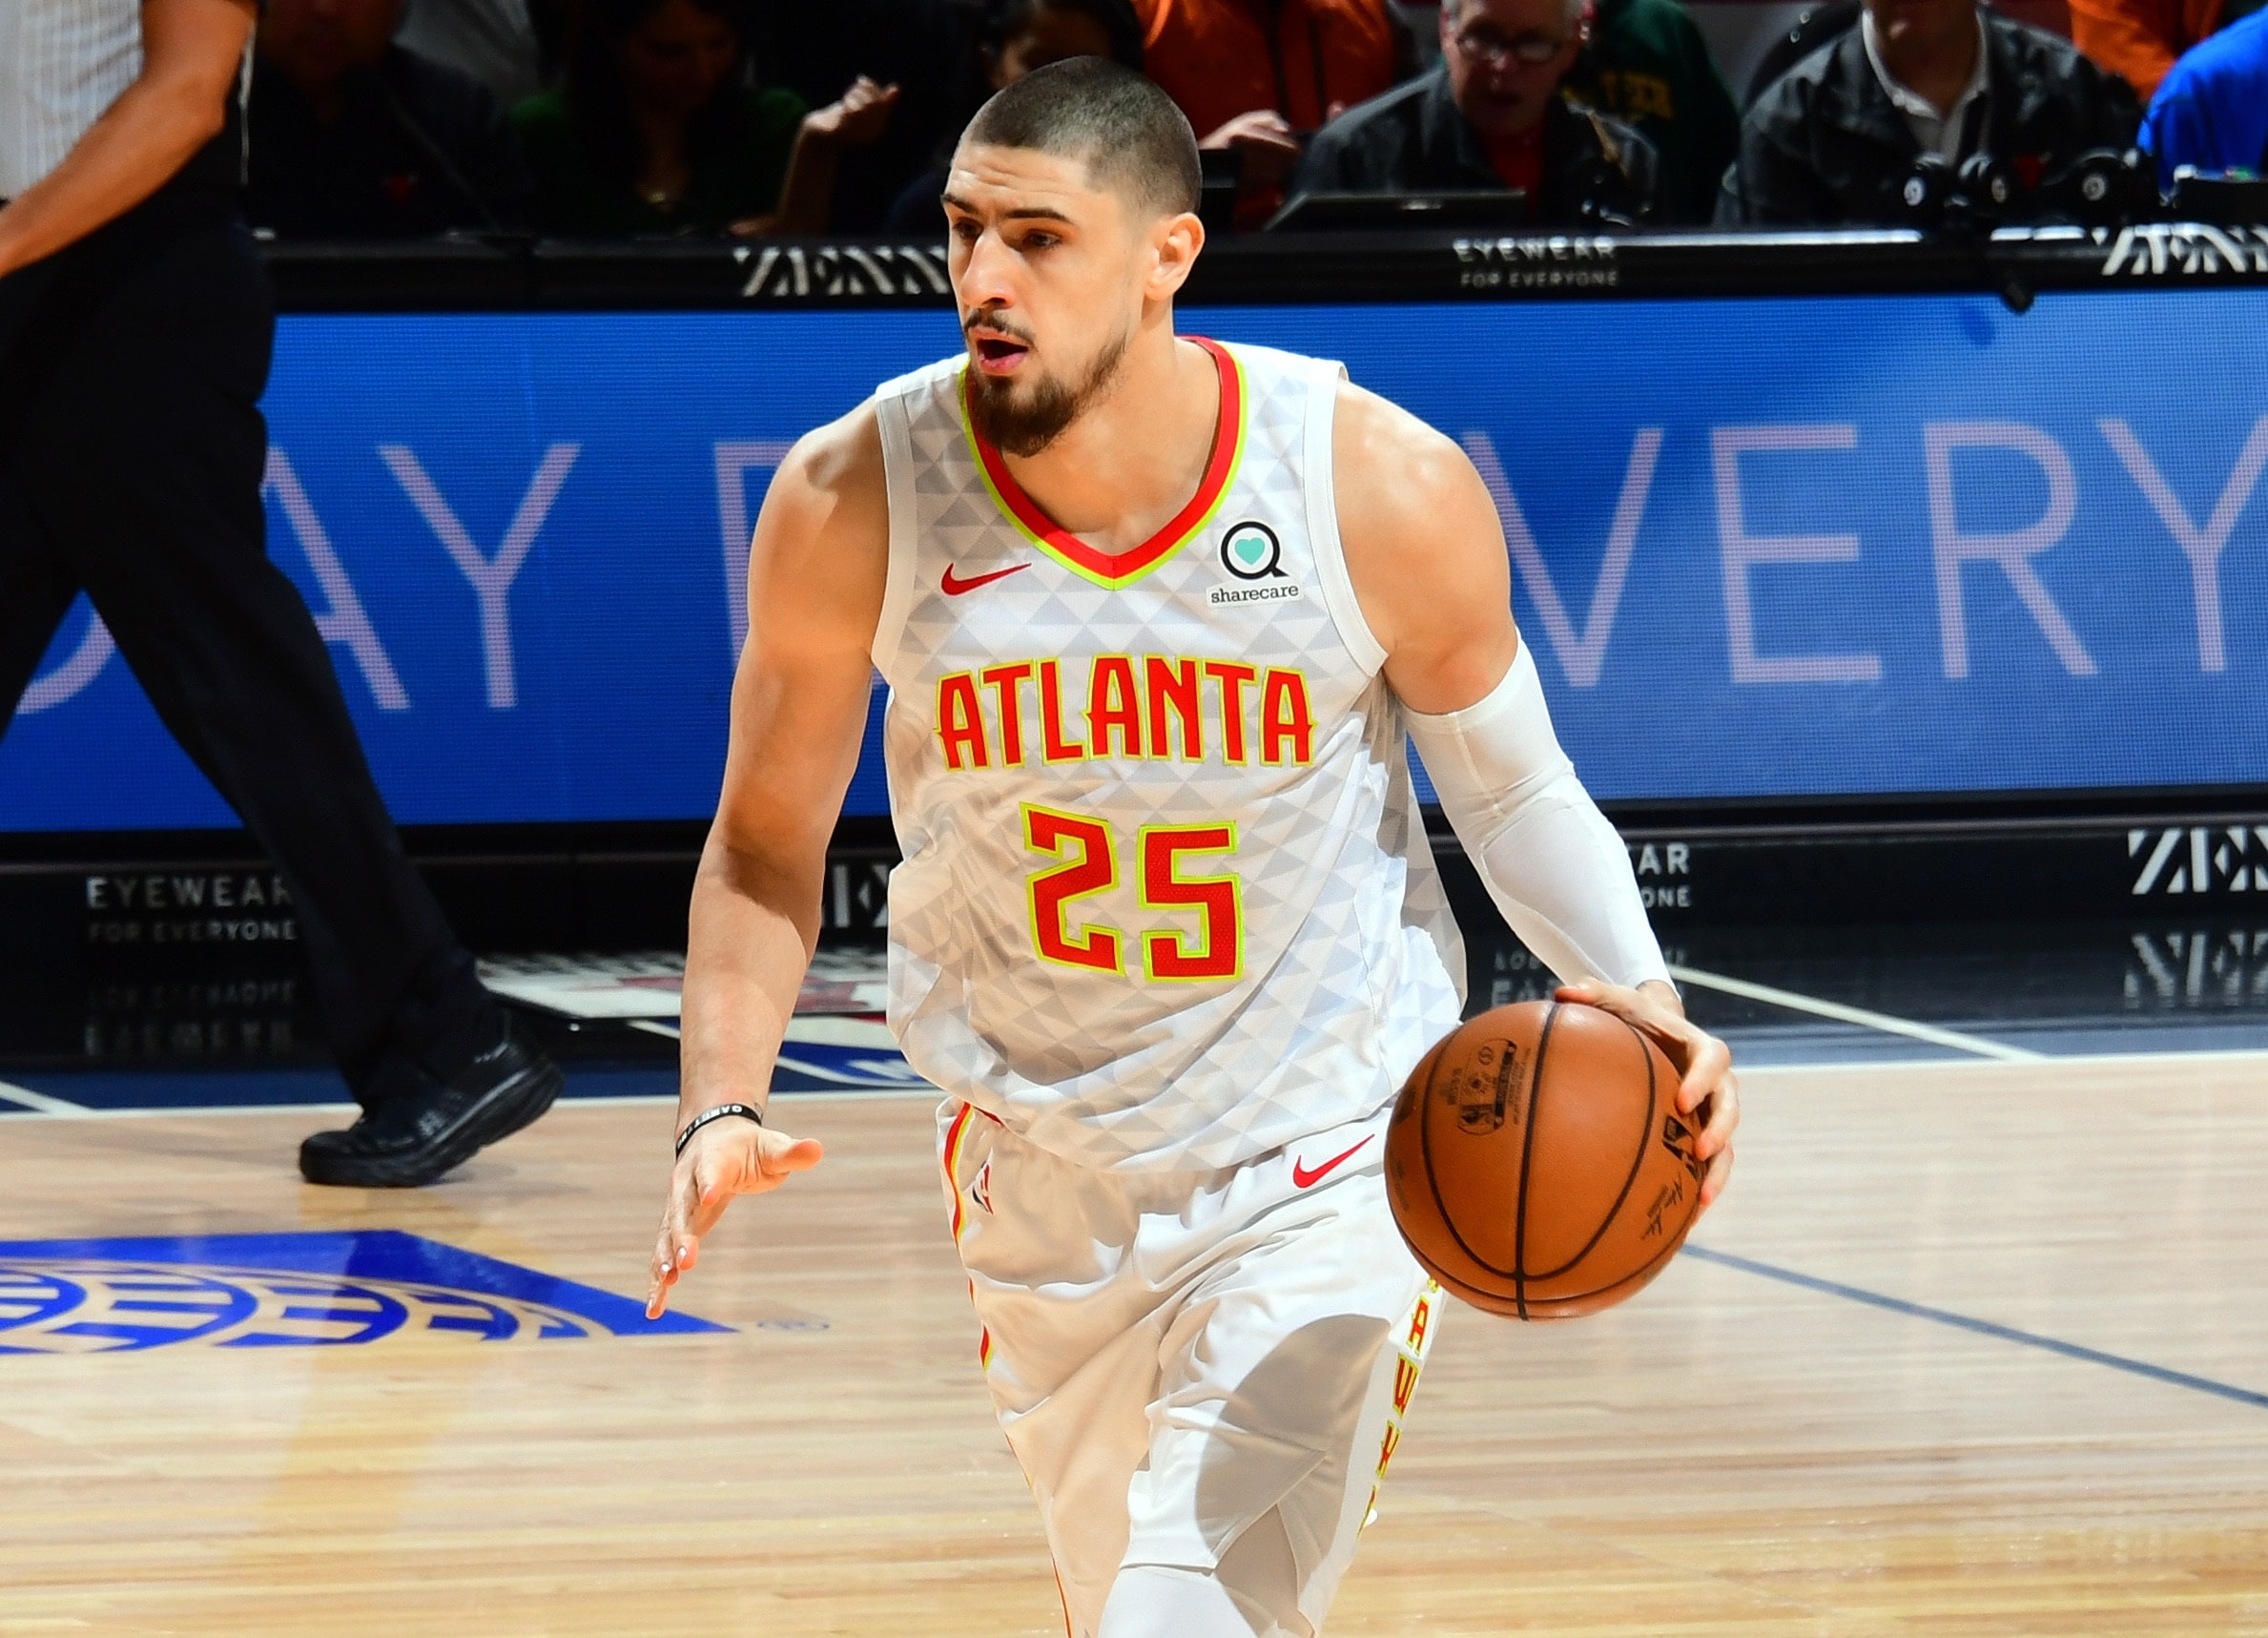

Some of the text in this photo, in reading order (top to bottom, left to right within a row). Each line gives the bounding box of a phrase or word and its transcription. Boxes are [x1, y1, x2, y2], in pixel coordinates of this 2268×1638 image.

[1453, 237, 1615, 262] EYEWEAR
[732, 245, 950, 297] ZENN
[1460, 270, 1618, 287] FOR EVERYONE
[16, 443, 582, 715] AY
[1462, 414, 2268, 687] VERY
[1211, 585, 1299, 604] sharecare
[933, 653, 1317, 771] ATLANTA
[87, 876, 292, 907] EYEWEAR
[1020, 802, 1244, 984] 25
[152, 919, 298, 943] EVERYONE
